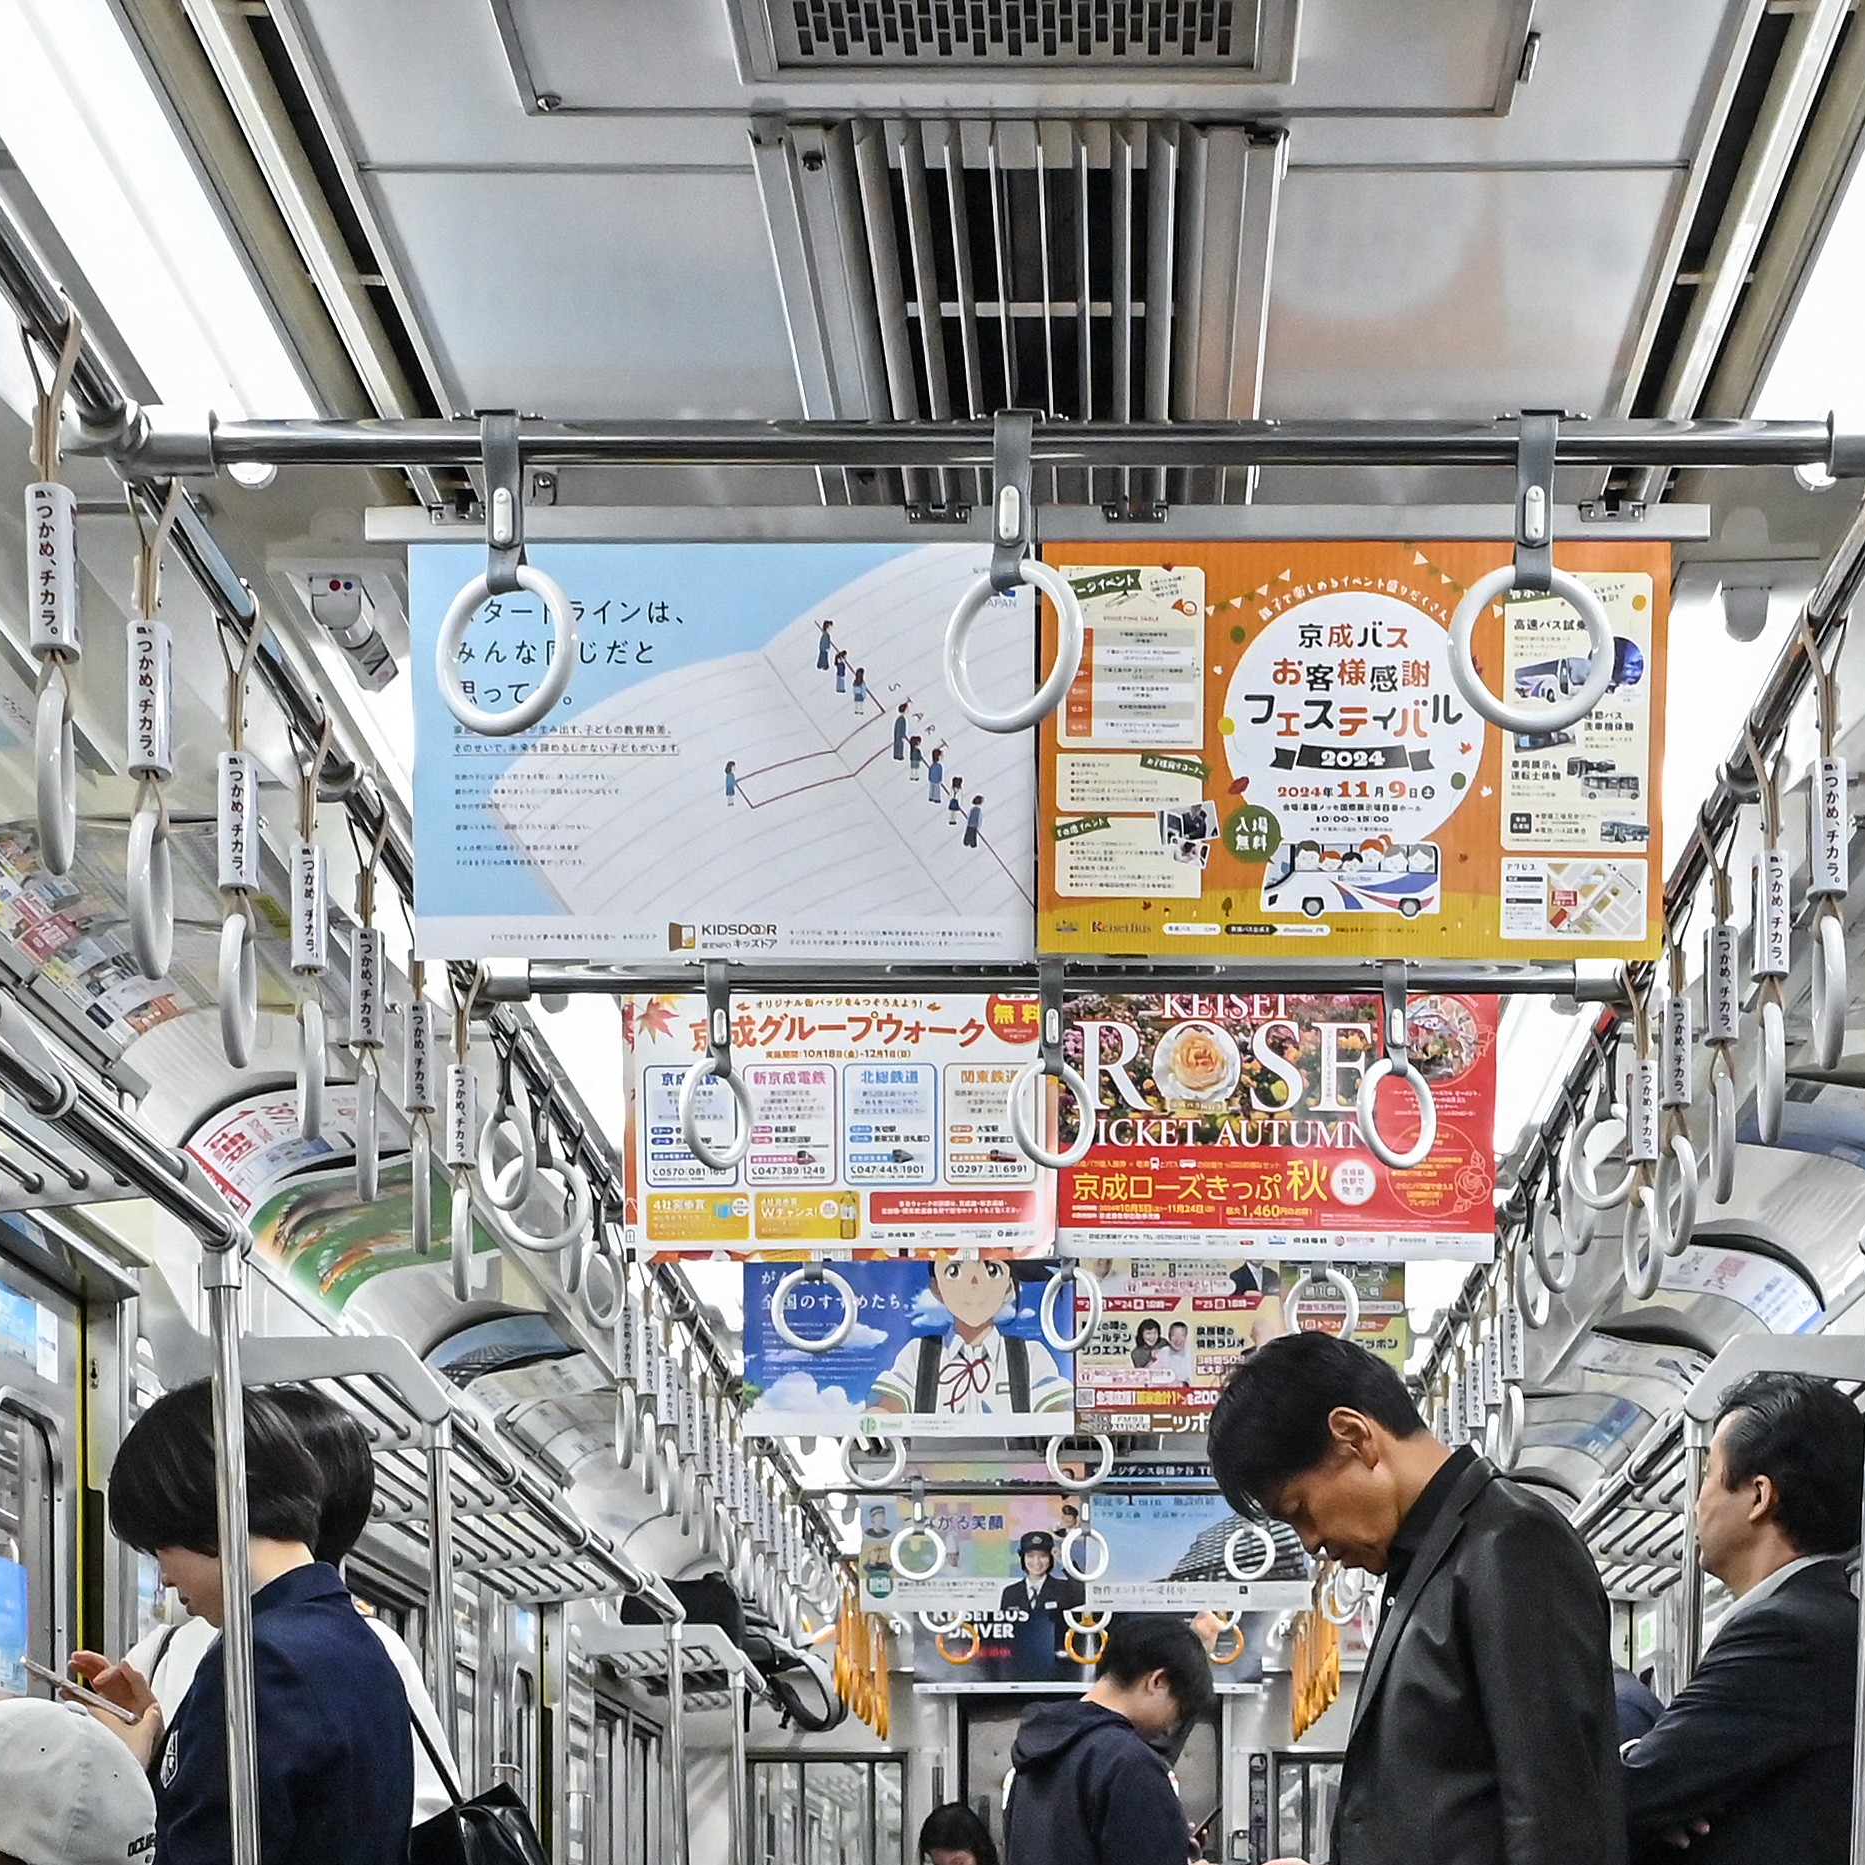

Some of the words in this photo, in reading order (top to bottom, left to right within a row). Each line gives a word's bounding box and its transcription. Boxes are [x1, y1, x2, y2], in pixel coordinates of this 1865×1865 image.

[36, 505, 59, 636] つかめ、チカラ。
[1073, 574, 1135, 594] ージイベント
[986, 599, 1016, 608] APAN
[1258, 576, 1448, 621] 親子で楽しめるイベント盛りだくさん
[470, 601, 684, 624] タートラインは、
[1298, 621, 1408, 648] 京成バス
[1272, 658, 1430, 692] お客様感謝
[138, 640, 154, 760] つかめ、チカラ。
[460, 681, 572, 704] 思って。
[889, 683, 949, 749] START
[1244, 694, 1462, 738] フェスティバル
[1585, 722, 1634, 731] 洗車機体験
[1320, 751, 1385, 767] 2024
[1511, 772, 1561, 780] 運転士体験
[1278, 781, 1417, 798] 2024年11月9日
[229, 769, 244, 878] つかめ、チカラ。
[1236, 817, 1268, 833] 入場
[1825, 774, 1840, 885] つかめ、チカラ。
[1236, 835, 1267, 851] 無料
[304, 857, 320, 958] つかめ、チカラ。
[1770, 860, 1783, 966] つかめ、チカラ。
[702, 924, 777, 935] KIDSDOOR
[360, 940, 373, 1035] つかめ、チカラ。
[1719, 943, 1731, 1034] つかめ、チカラ。
[755, 997, 924, 1010] オリジナル缶バッジを4つそろえよう!
[993, 1003, 1040, 1024] 無料
[1163, 993, 1285, 1019] KEISEI
[690, 1013, 986, 1052] 京成グループウォーク
[413, 1014, 426, 1101] つかめ、チカラ。
[1073, 1020, 1372, 1112] ROSE
[1674, 1008, 1685, 1098] つかめ、チカラ。
[754, 1071, 826, 1084] 新京成電鉄
[861, 1070, 919, 1084] 北総鉄道
[961, 1070, 1018, 1083] 関東鉄道
[457, 1075, 467, 1159] つかめ、チカラ。
[1641, 1072, 1653, 1156] つかめ、チカラ。
[1072, 1173, 1282, 1201] 京成ローズきっぷ
[1287, 1160, 1328, 1201] 秋
[762, 1207, 817, 1218] Wチャンス!
[1086, 1333, 1131, 1341] ールデン
[996, 1611, 1029, 1622] BUS
